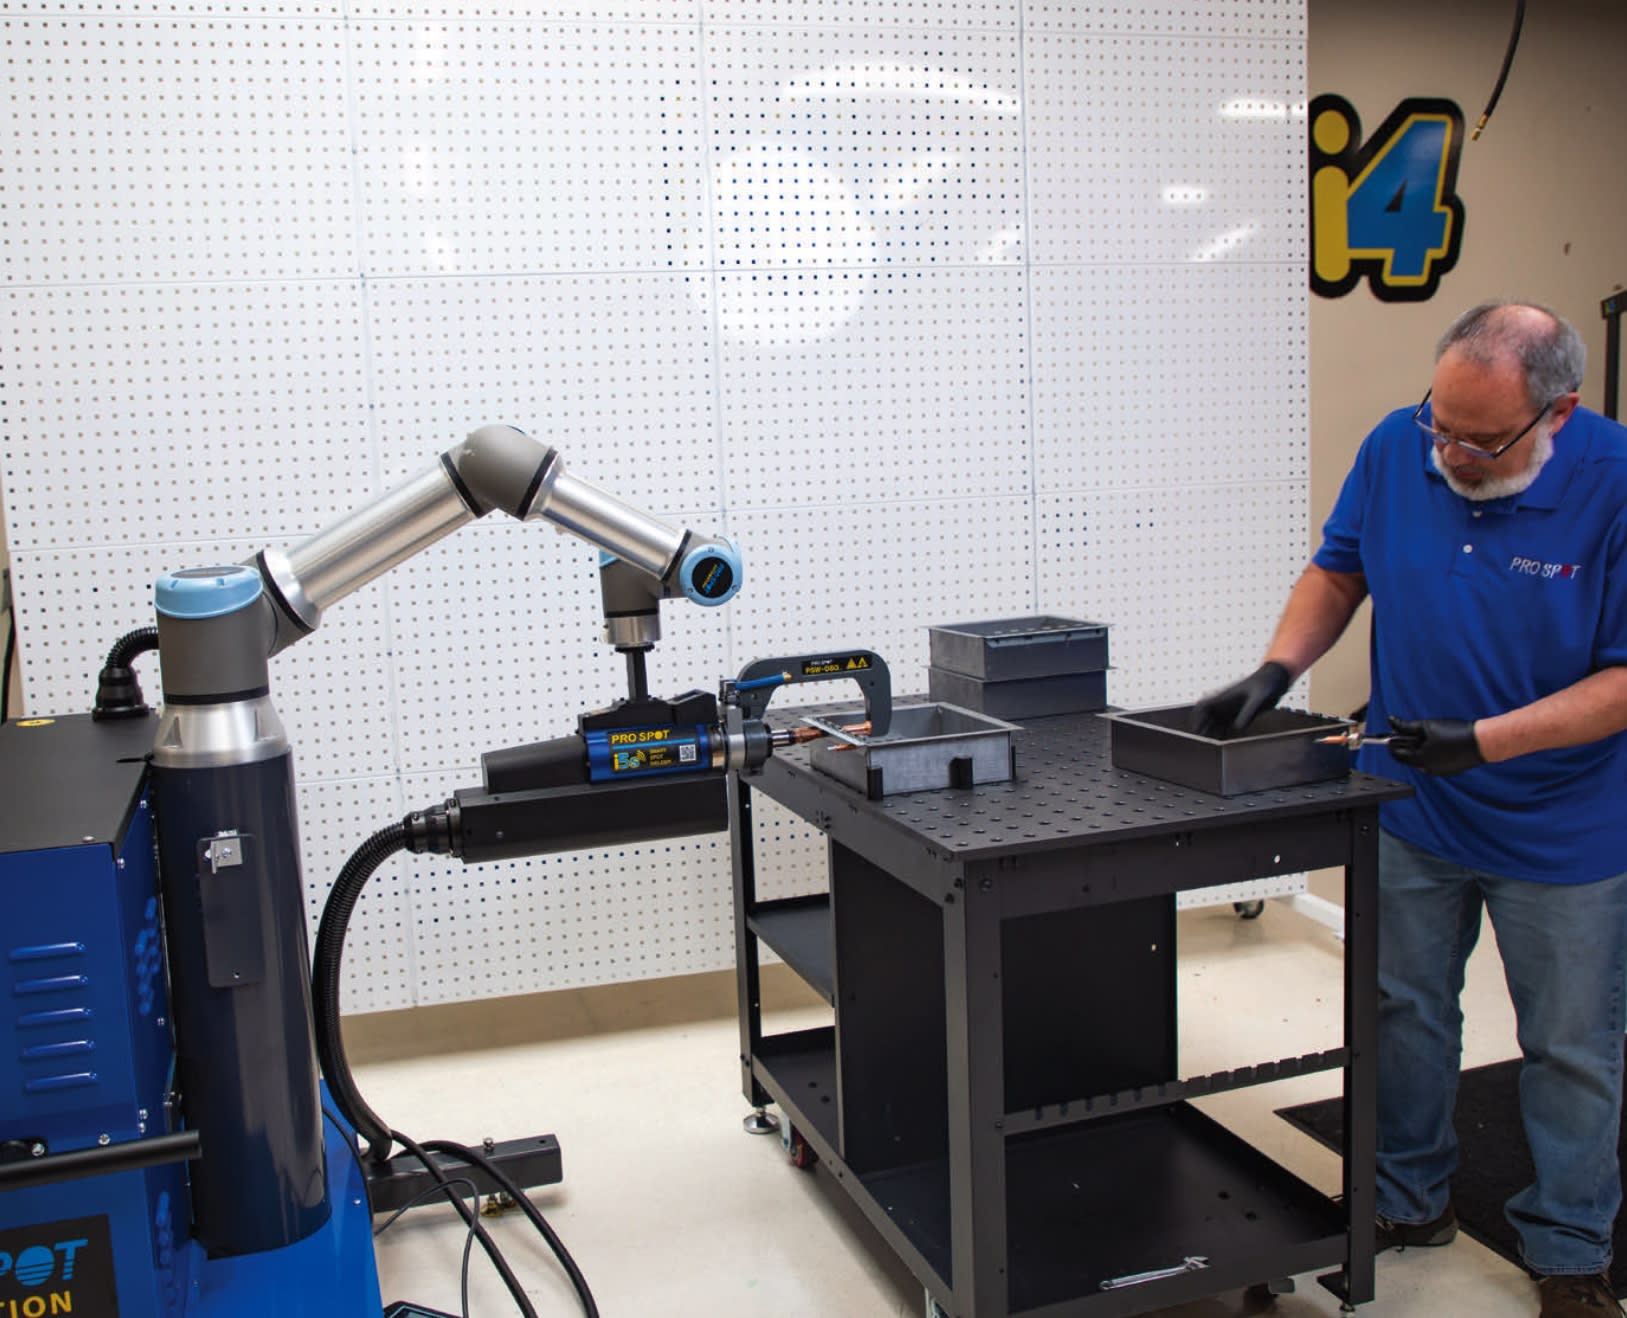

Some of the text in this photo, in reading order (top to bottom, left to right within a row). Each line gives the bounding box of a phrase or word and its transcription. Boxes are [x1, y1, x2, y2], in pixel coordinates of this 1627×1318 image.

[1312, 107, 1456, 289] i4
[1509, 556, 1582, 579] PRO SPOT
[611, 729, 670, 744] PRO SPOT
[0, 1290, 72, 1318] ION
